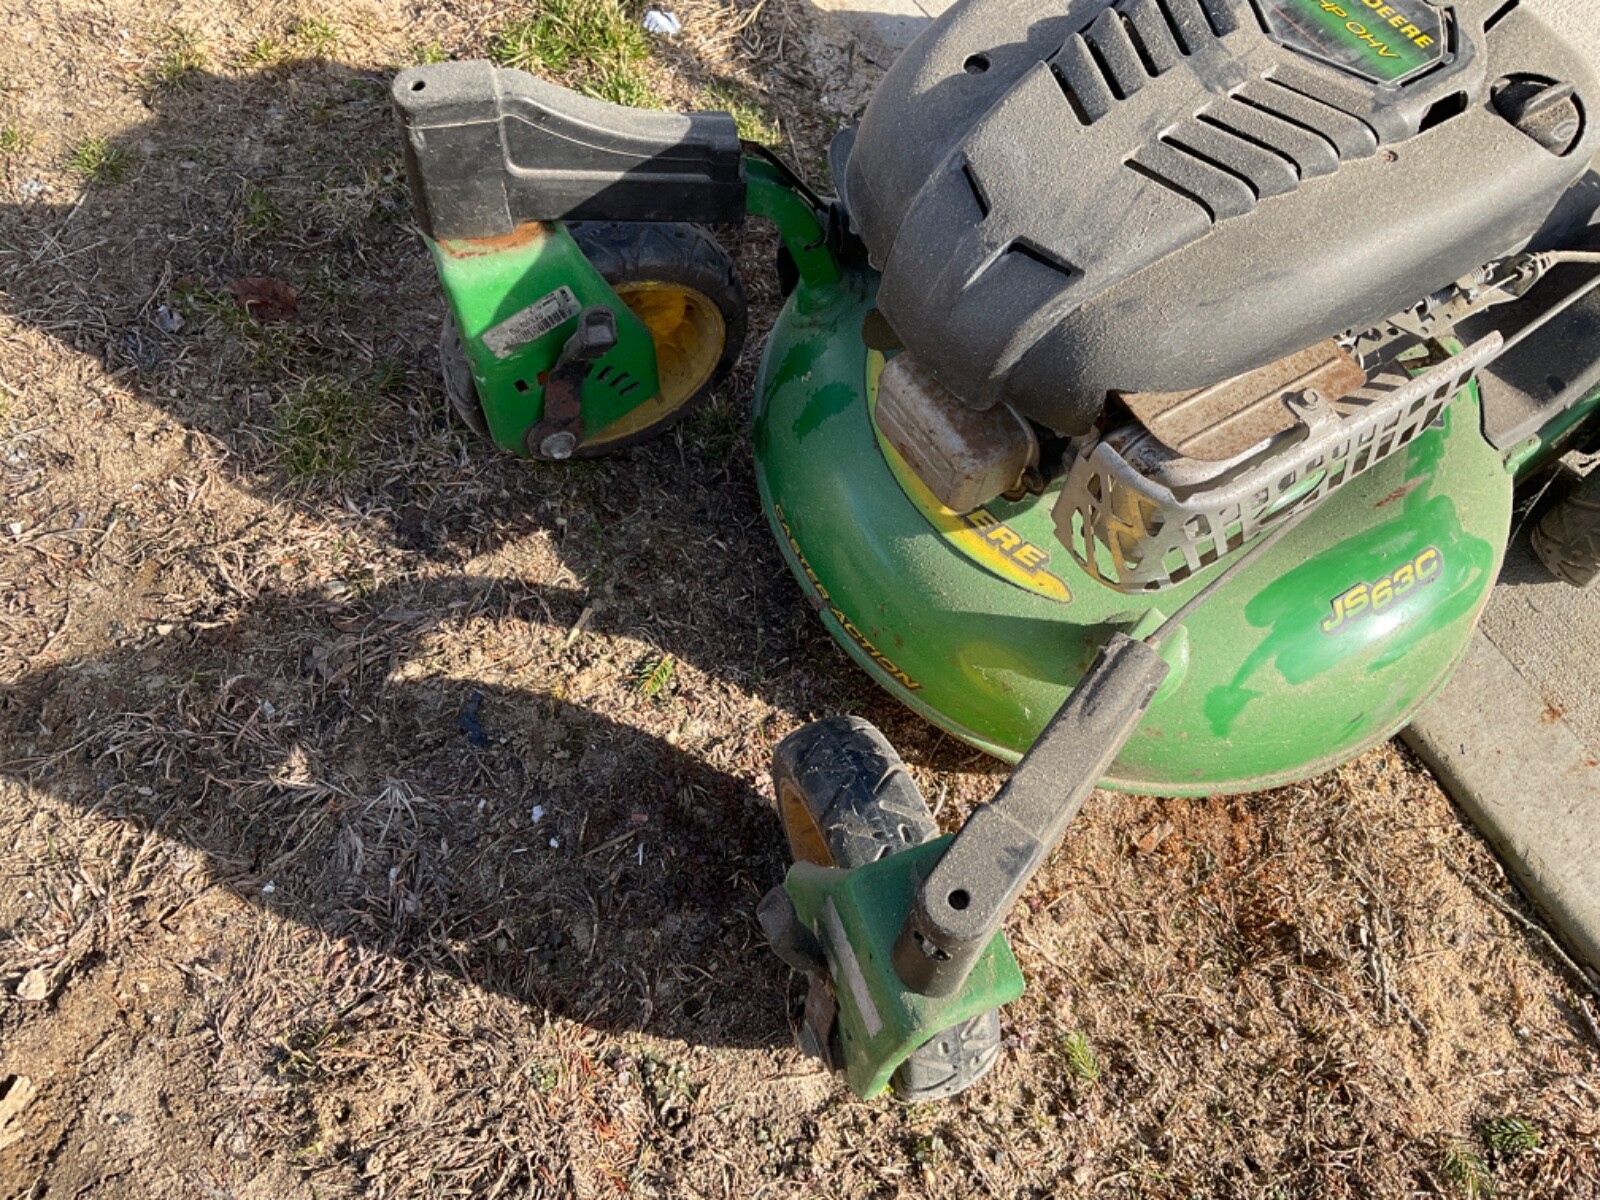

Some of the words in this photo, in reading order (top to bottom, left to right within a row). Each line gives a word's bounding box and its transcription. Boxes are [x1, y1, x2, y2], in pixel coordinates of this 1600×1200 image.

[1345, 21, 1401, 58] OHV
[1362, 0, 1435, 49] DEERE
[964, 506, 1050, 572] ERE
[1322, 547, 1440, 633] JS63C
[830, 607, 923, 690] ACTION
